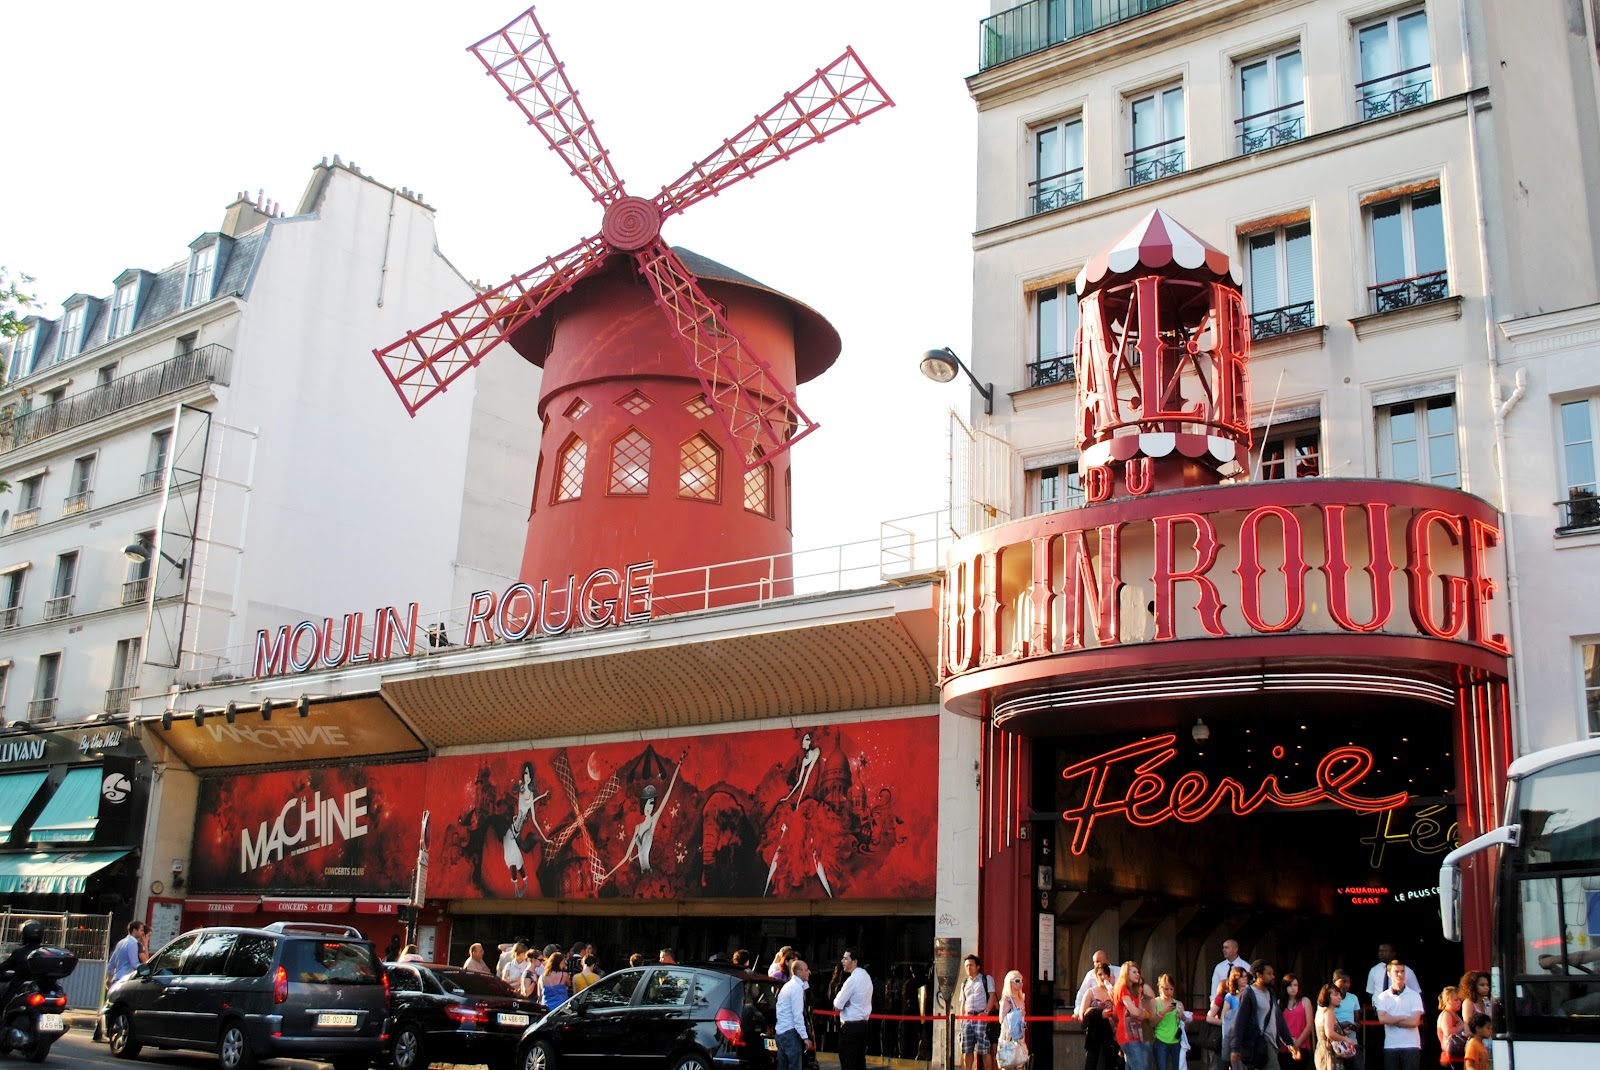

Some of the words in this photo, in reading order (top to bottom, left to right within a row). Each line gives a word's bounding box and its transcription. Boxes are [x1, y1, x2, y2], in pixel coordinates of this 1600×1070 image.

[1085, 457, 1153, 502] DU
[938, 523, 1128, 688] ULIN
[1150, 502, 1512, 657] ROUGE
[252, 602, 418, 678] MOULIN
[464, 559, 658, 648] ROUGE
[0, 739, 47, 763] LIVANS
[79, 735, 90, 754] By
[90, 733, 103, 749] the
[103, 730, 122, 747] Mill
[1062, 732, 1410, 856] Féerie
[241, 787, 368, 874] MACHINE
[324, 866, 350, 876] CONCERTS
[351, 867, 365, 876] CLUB
[207, 903, 234, 911] TERRASSE
[278, 902, 308, 911] CONCERTS
[317, 902, 333, 912] CLUB
[378, 903, 392, 913] BAR
[1394, 893, 1406, 903] LE
[1407, 889, 1431, 900] PLUS
